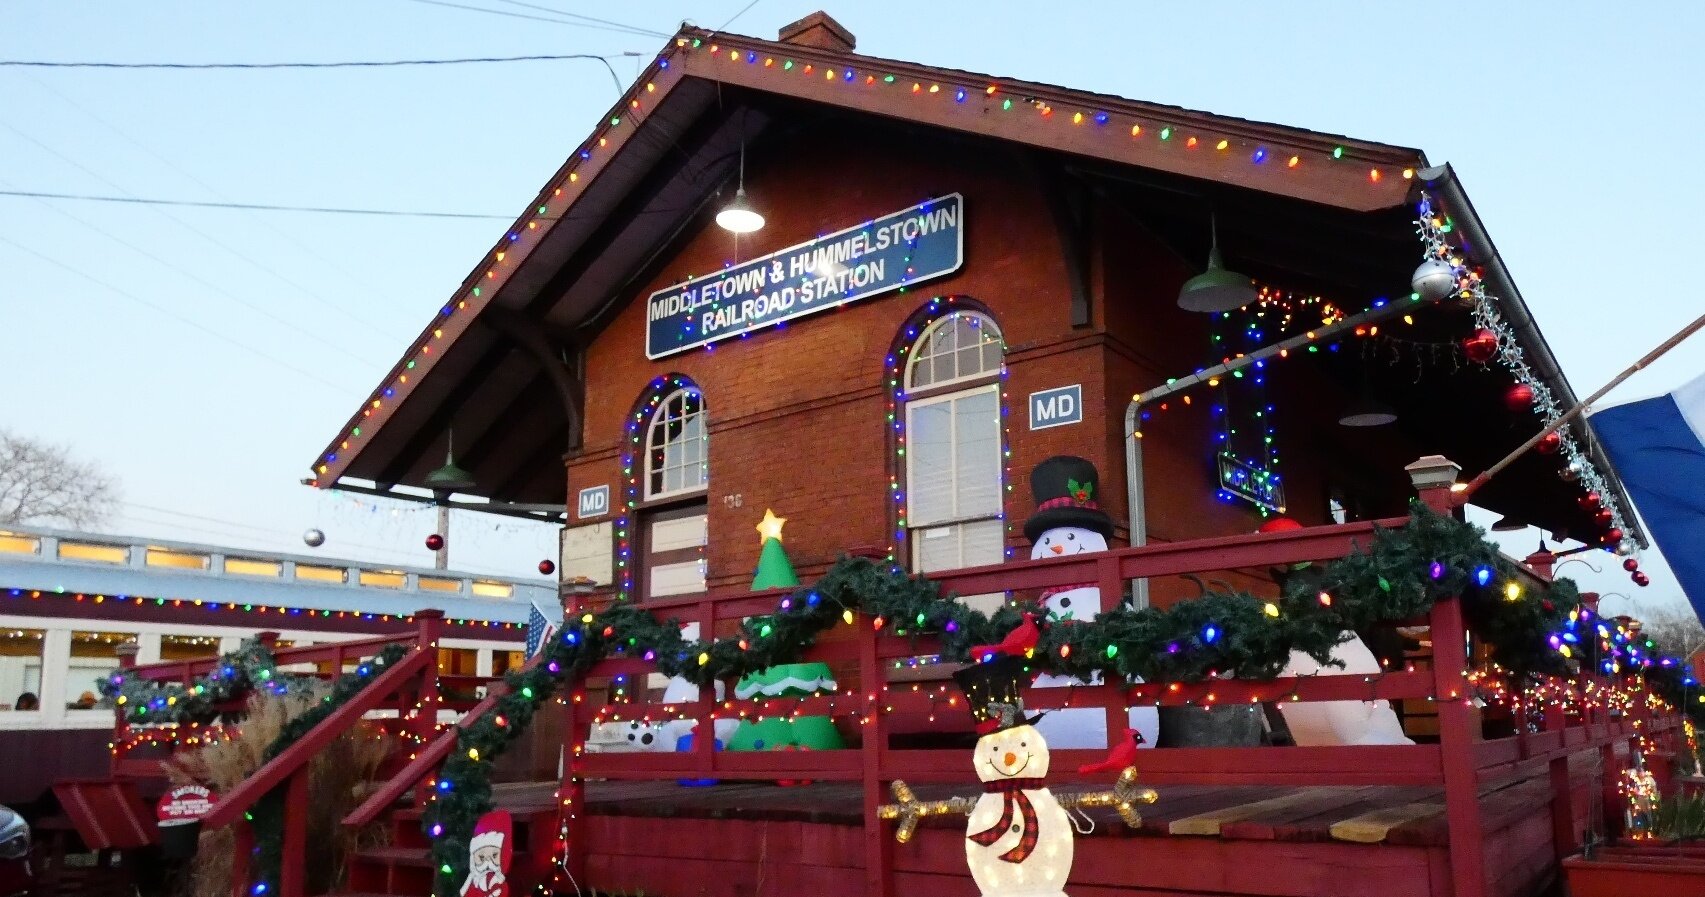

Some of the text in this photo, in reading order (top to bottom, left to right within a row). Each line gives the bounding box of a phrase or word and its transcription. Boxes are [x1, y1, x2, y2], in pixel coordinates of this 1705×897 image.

[651, 204, 957, 322] MIDDLETOWN & HUMMELSTOWN
[702, 259, 885, 332] RAILROAD STATION
[1036, 394, 1074, 422] MD
[583, 492, 605, 512] MD
